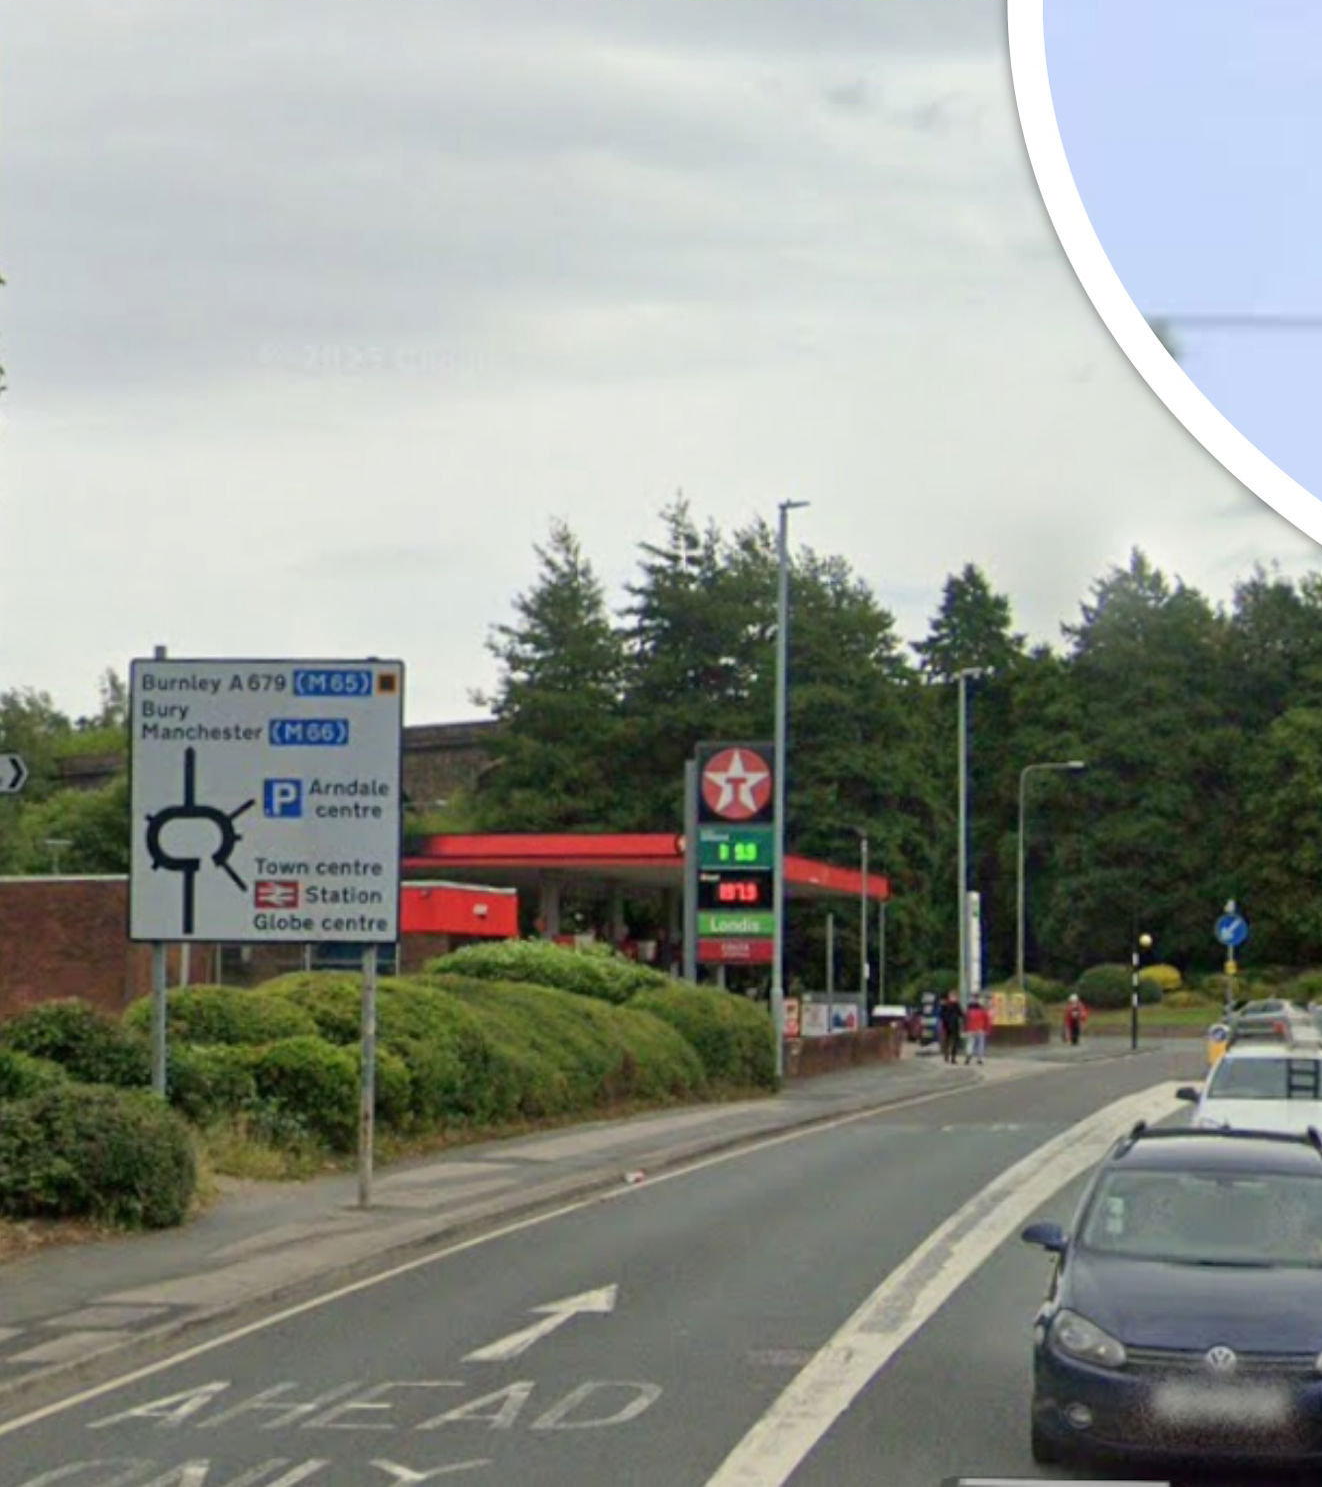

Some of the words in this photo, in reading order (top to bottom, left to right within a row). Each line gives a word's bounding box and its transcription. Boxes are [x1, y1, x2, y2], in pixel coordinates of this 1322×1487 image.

[141, 674, 221, 694] Burnley
[141, 700, 189, 721] Bury
[141, 723, 263, 741] Manchester
[308, 778, 390, 797] Arndale
[315, 801, 383, 819] centre
[254, 857, 310, 876] Town
[315, 858, 384, 876] centre
[305, 885, 383, 905] Station
[253, 913, 314, 932] Globe
[321, 914, 389, 933] centre
[709, 916, 761, 933] Londis
[86, 1380, 664, 1430] AHEAD
